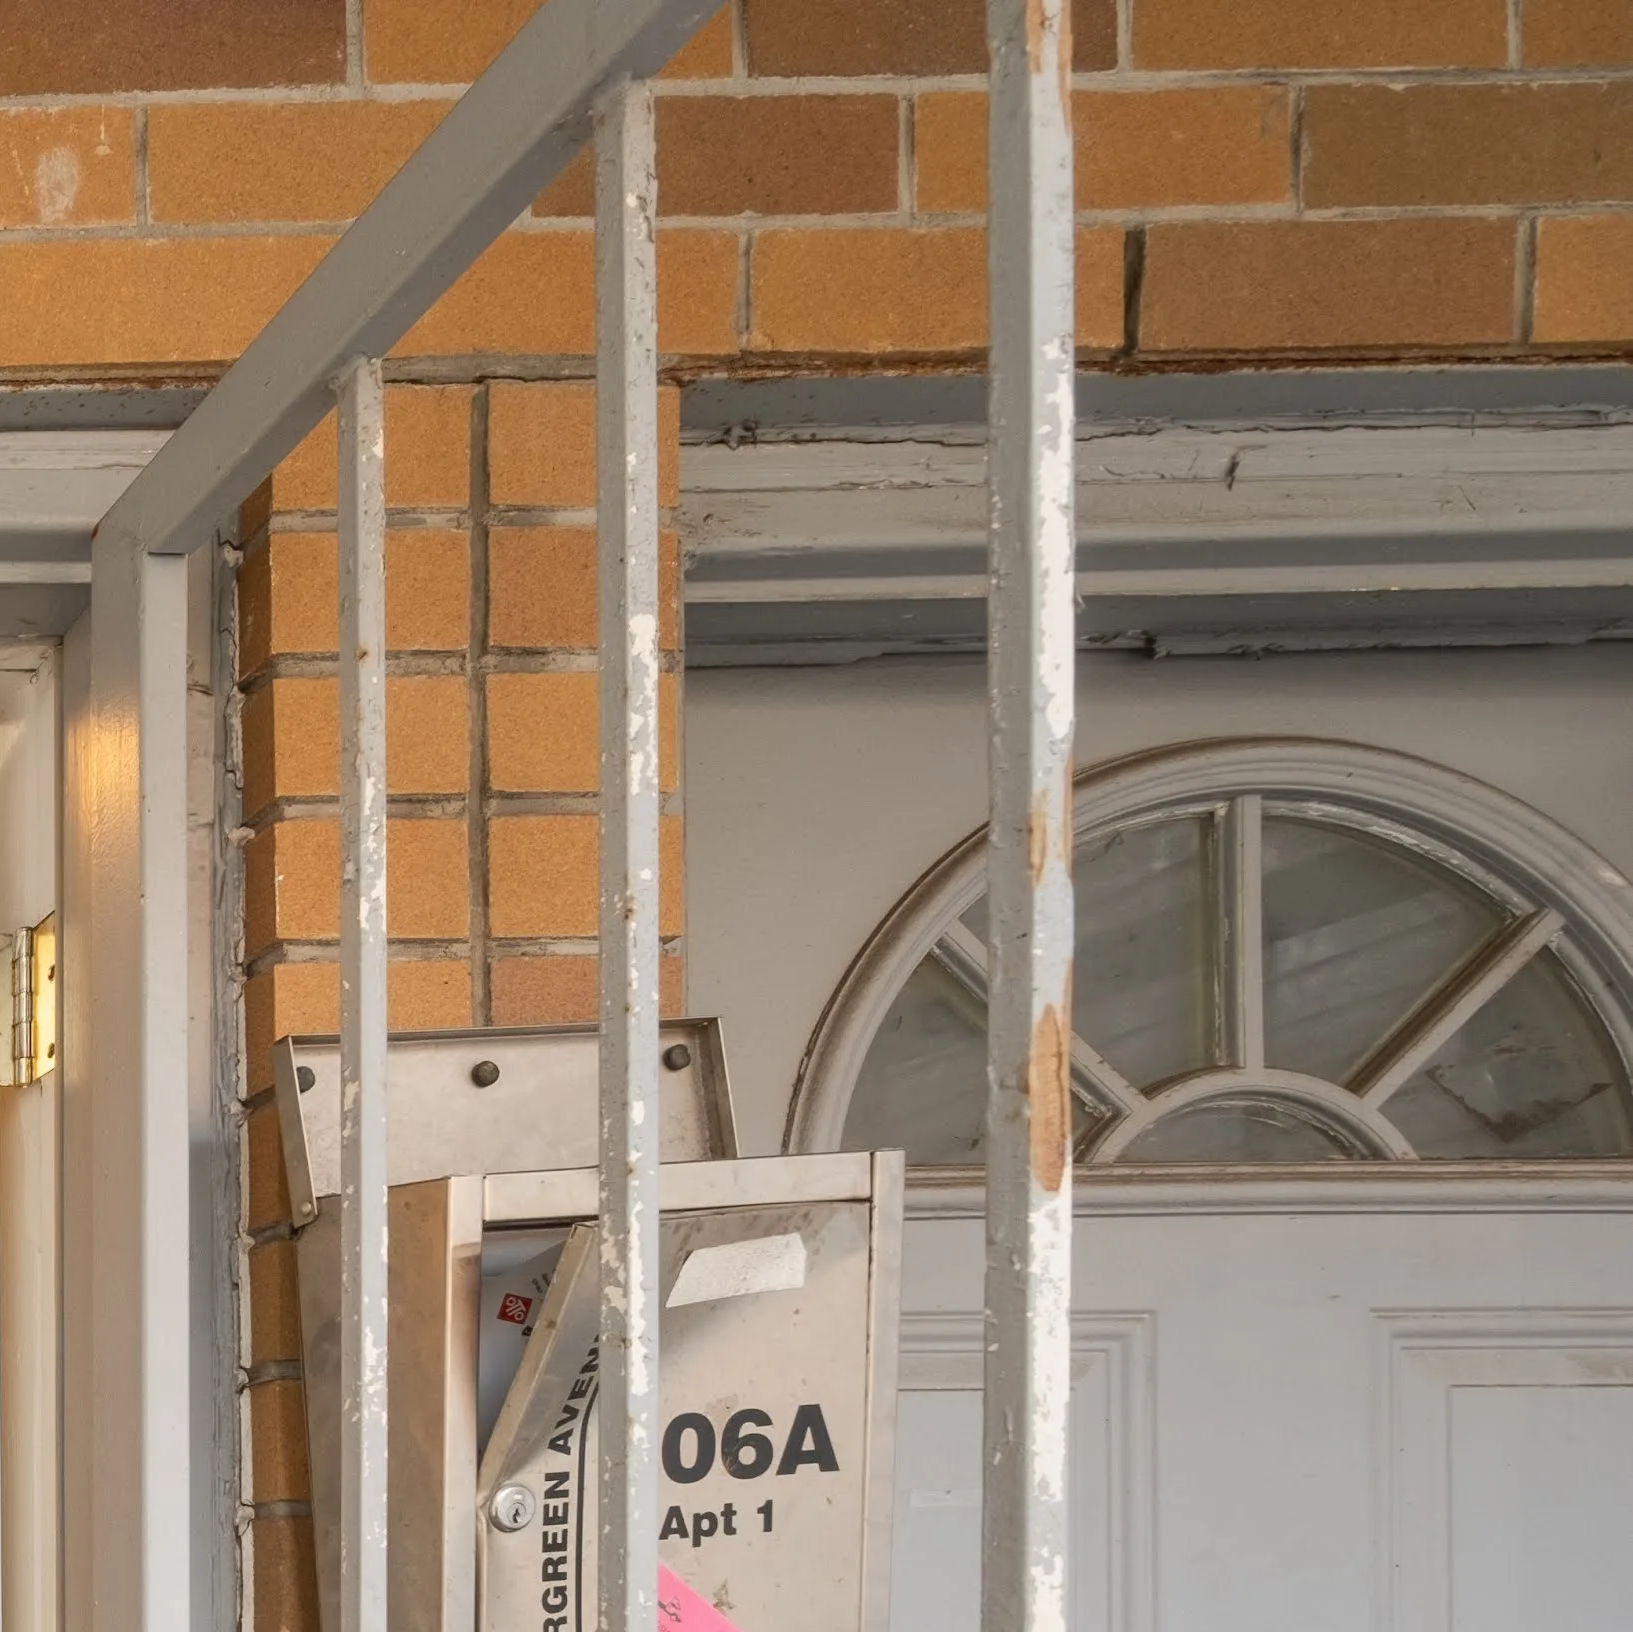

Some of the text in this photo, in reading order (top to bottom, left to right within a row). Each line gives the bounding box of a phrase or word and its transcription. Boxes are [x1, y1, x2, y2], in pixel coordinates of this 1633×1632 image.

[547, 1334, 599, 1456] AVEN
[659, 1403, 840, 1484] 06A
[658, 1499, 773, 1548] Apt 1
